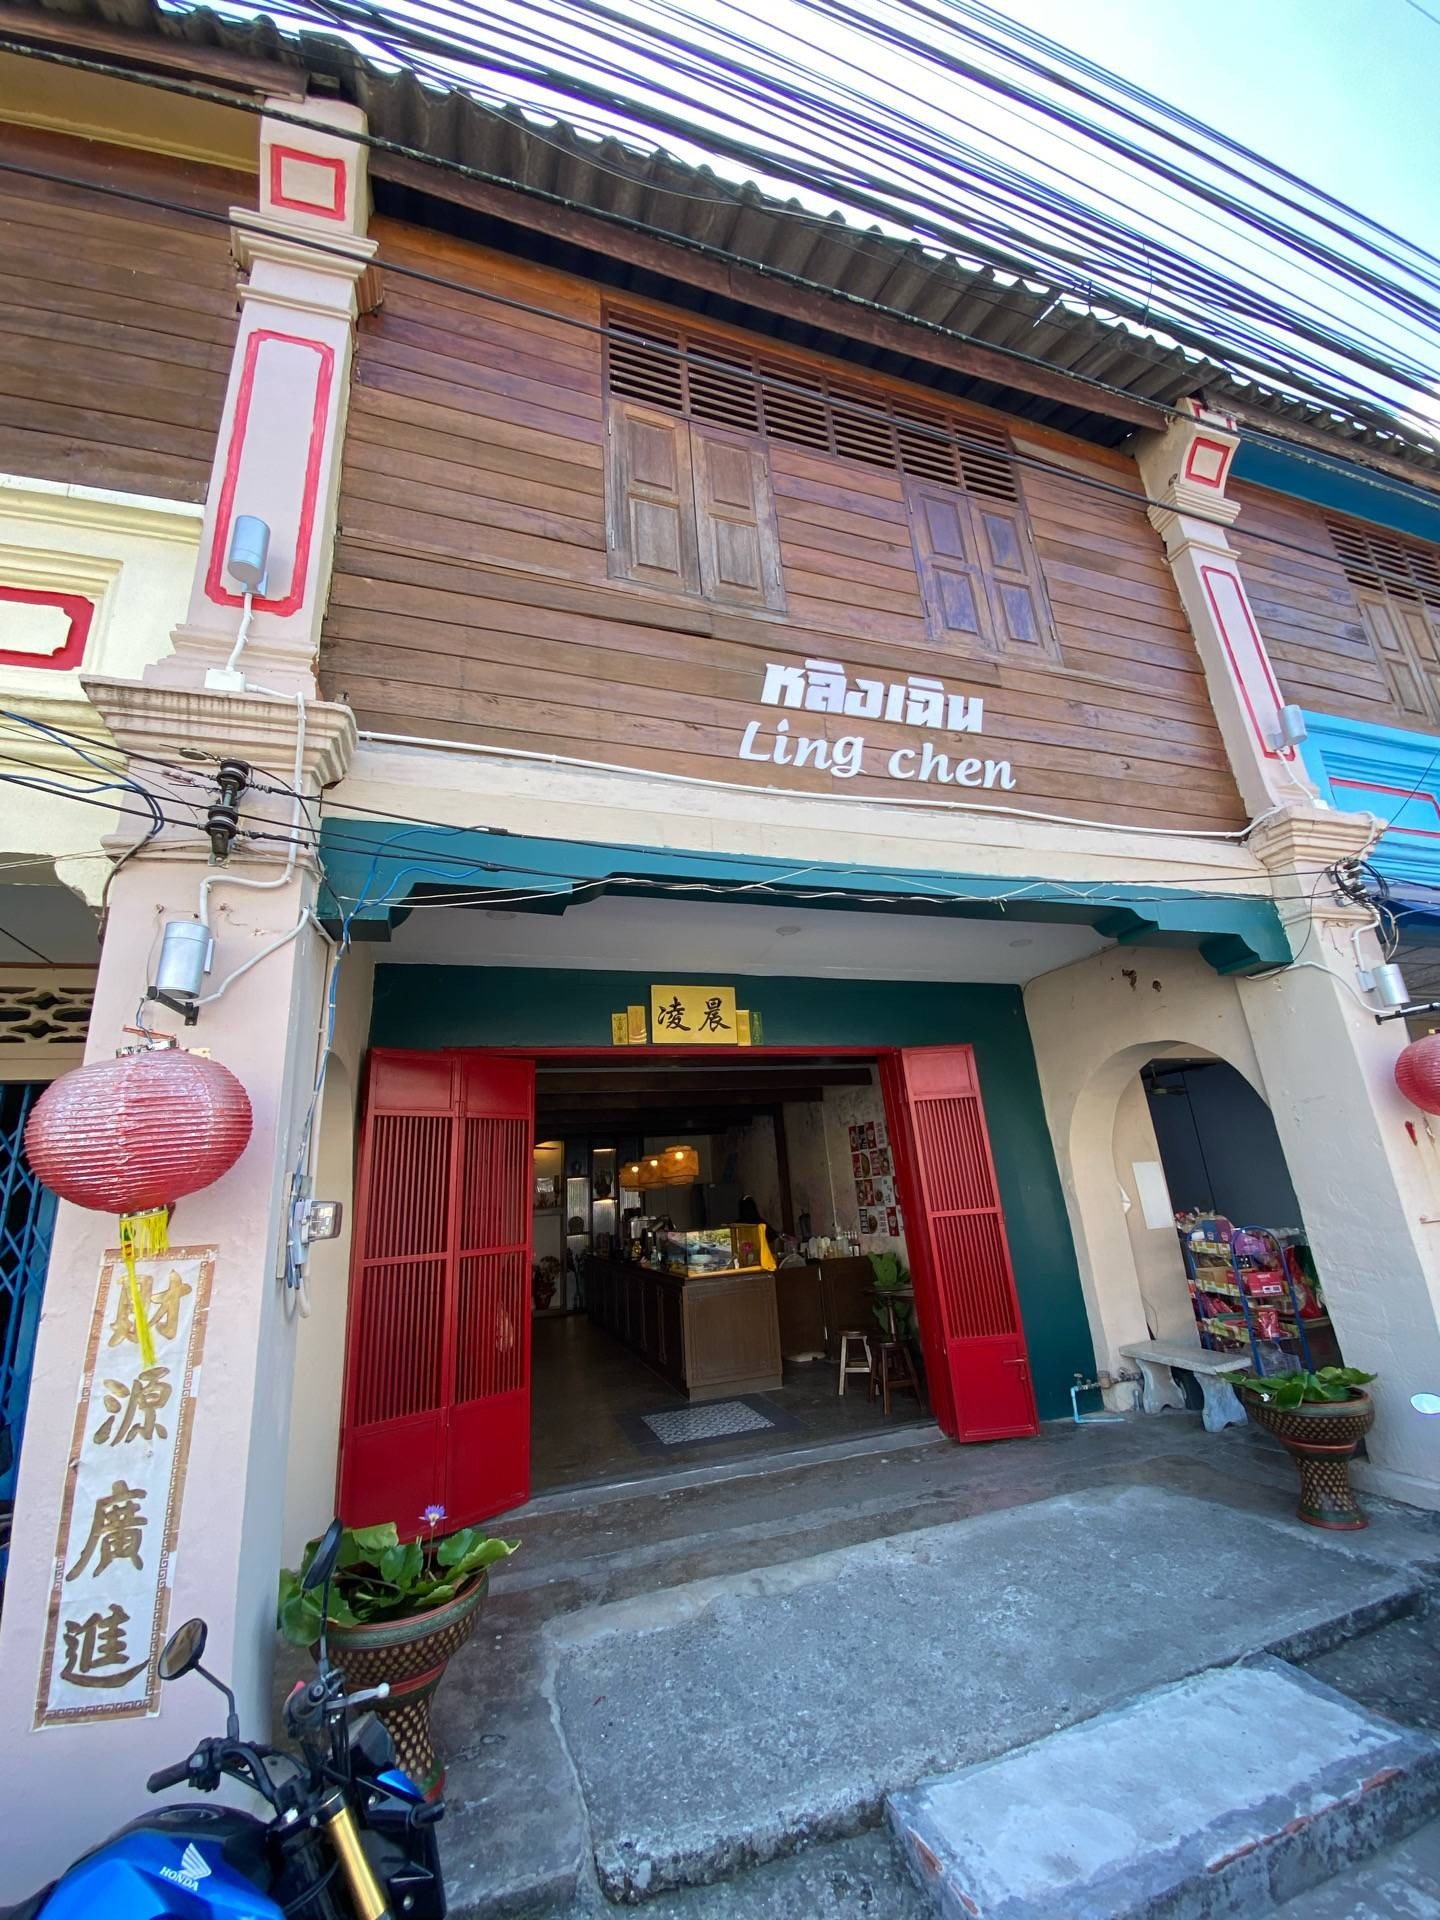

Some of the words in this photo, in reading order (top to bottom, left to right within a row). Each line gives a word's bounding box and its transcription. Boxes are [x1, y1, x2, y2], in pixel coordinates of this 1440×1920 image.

[738, 719, 867, 778] Ling
[888, 743, 1016, 790] chen
[657, 996, 732, 1033] 凌晨
[60, 1269, 192, 1689] 財源廣進
[159, 1866, 200, 1892] HONDA
